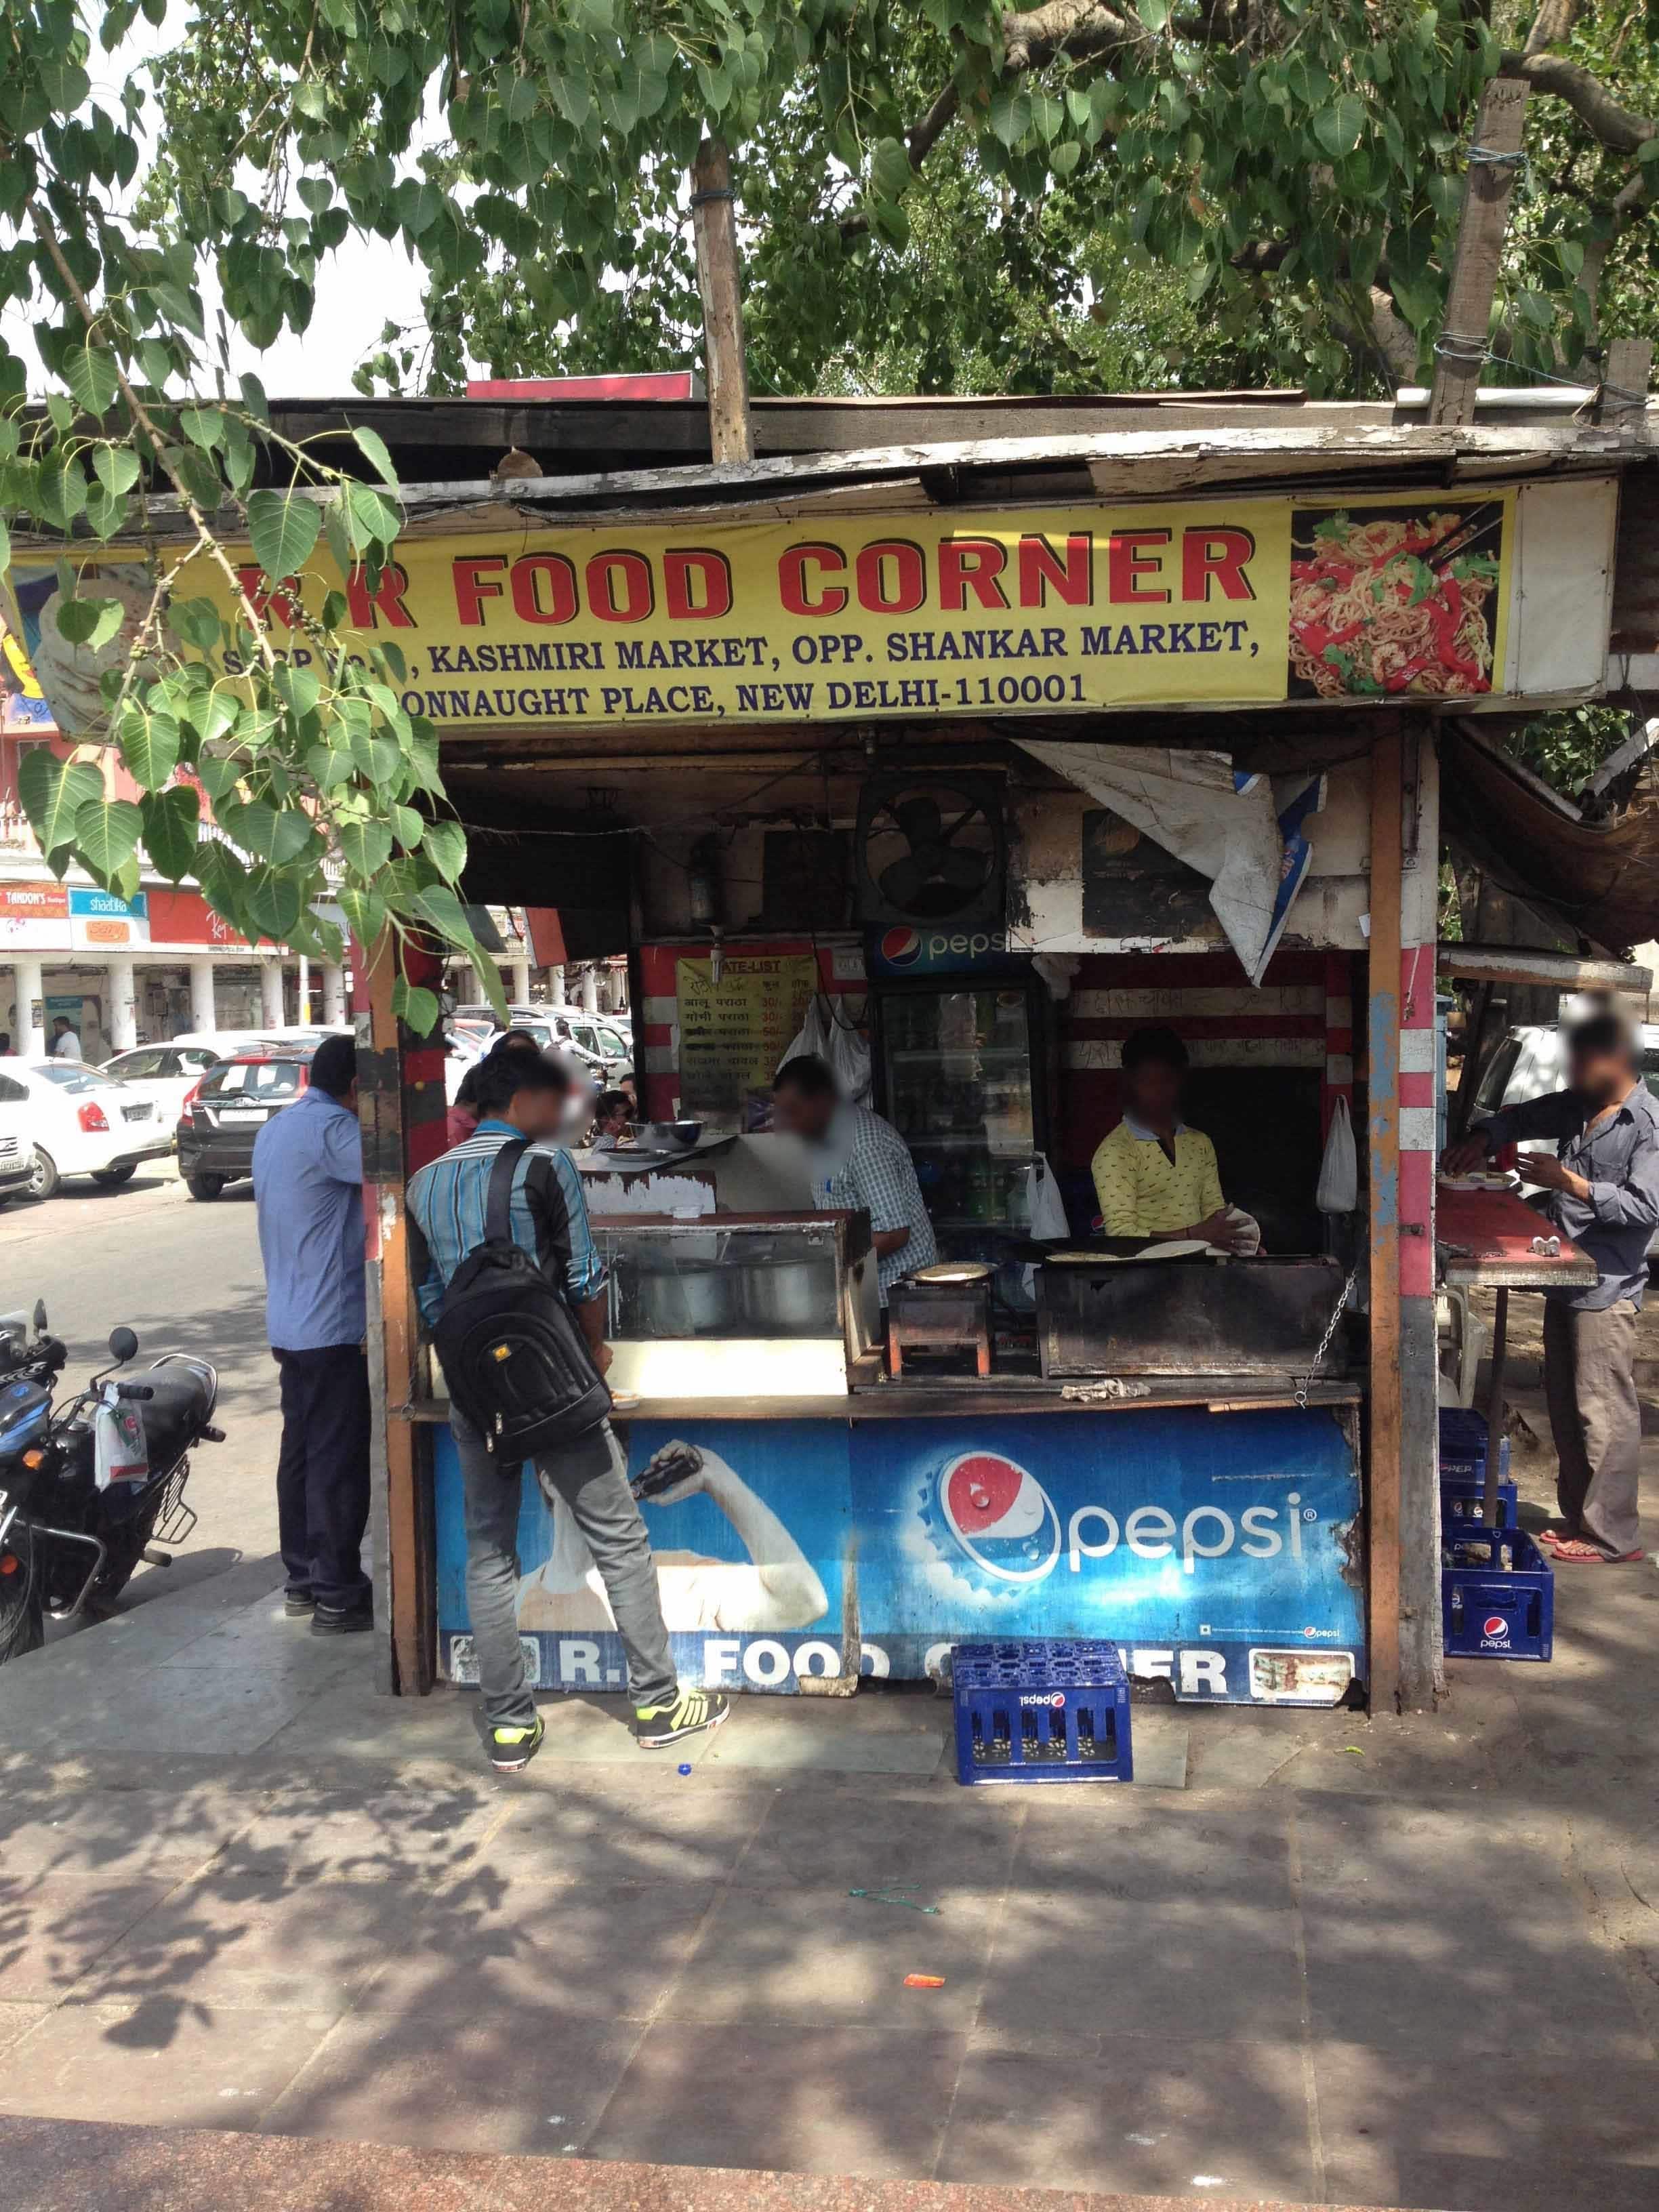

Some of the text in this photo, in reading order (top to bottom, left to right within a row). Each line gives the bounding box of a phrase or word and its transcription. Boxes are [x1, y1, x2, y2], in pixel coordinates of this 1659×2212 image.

[452, 547, 733, 626] FOOD
[778, 526, 1257, 617] CORNER
[427, 642, 605, 673] KASHMIRI
[615, 636, 780, 672] MARKET,
[792, 634, 874, 665] OPP.
[886, 628, 1069, 663] SHANKAR
[1080, 619, 1259, 658] MARKET,
[394, 674, 1087, 719] ONNAUGHT PLACE, NEW DELHI-110001
[929, 933, 1006, 960] peps
[721, 960, 781, 972] ATE-LIST
[1068, 1492, 1302, 1574] pepsi
[1315, 1629, 1340, 1639] pepsi
[1480, 1639, 1511, 1649] pepsi
[1019, 1694, 1051, 1706] pepsi
